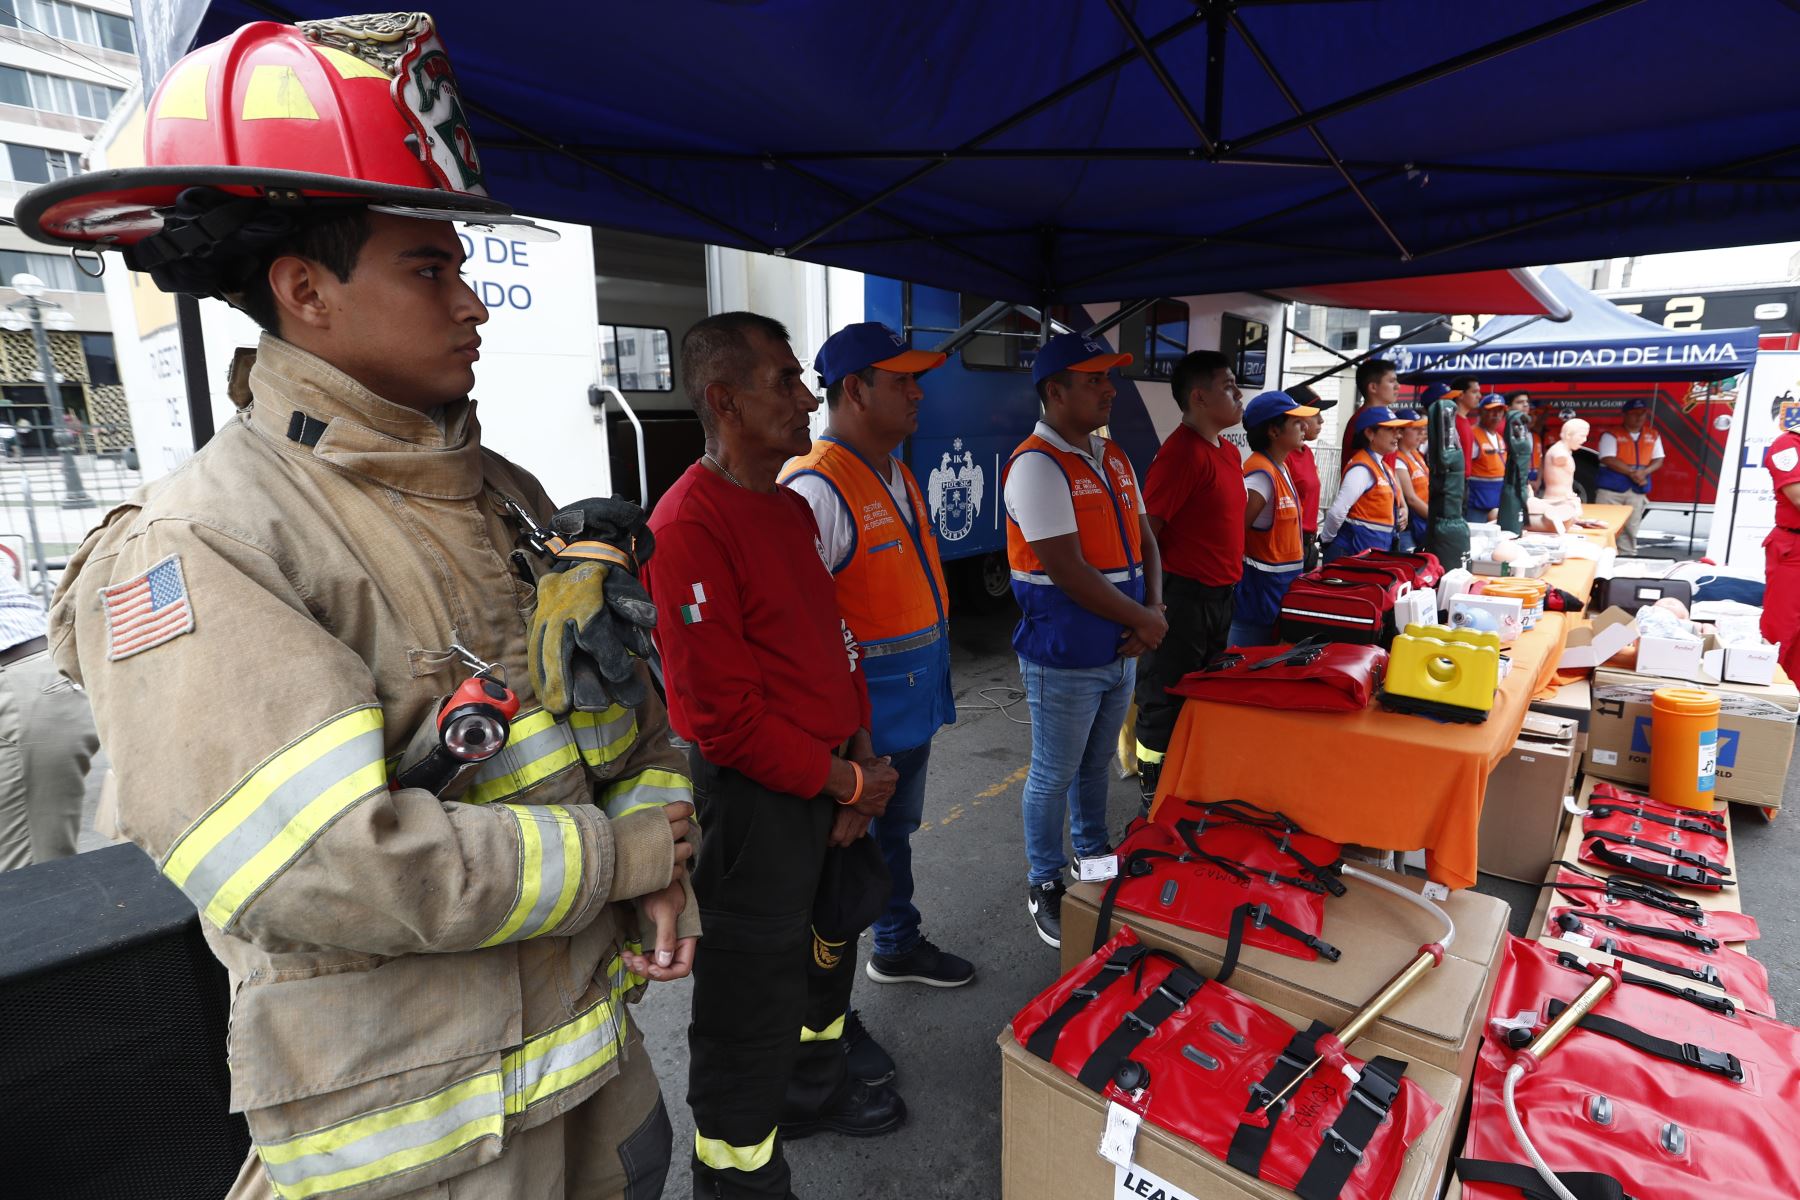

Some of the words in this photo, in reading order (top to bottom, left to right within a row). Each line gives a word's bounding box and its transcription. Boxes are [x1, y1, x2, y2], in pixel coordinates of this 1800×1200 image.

[485, 237, 529, 267] DE
[1663, 296, 1705, 332] 2
[1424, 348, 1616, 371] MUNICIPALIDAD
[1623, 346, 1659, 364] DE
[1666, 342, 1738, 363] LIMA
[1629, 755, 1648, 764] FOR
